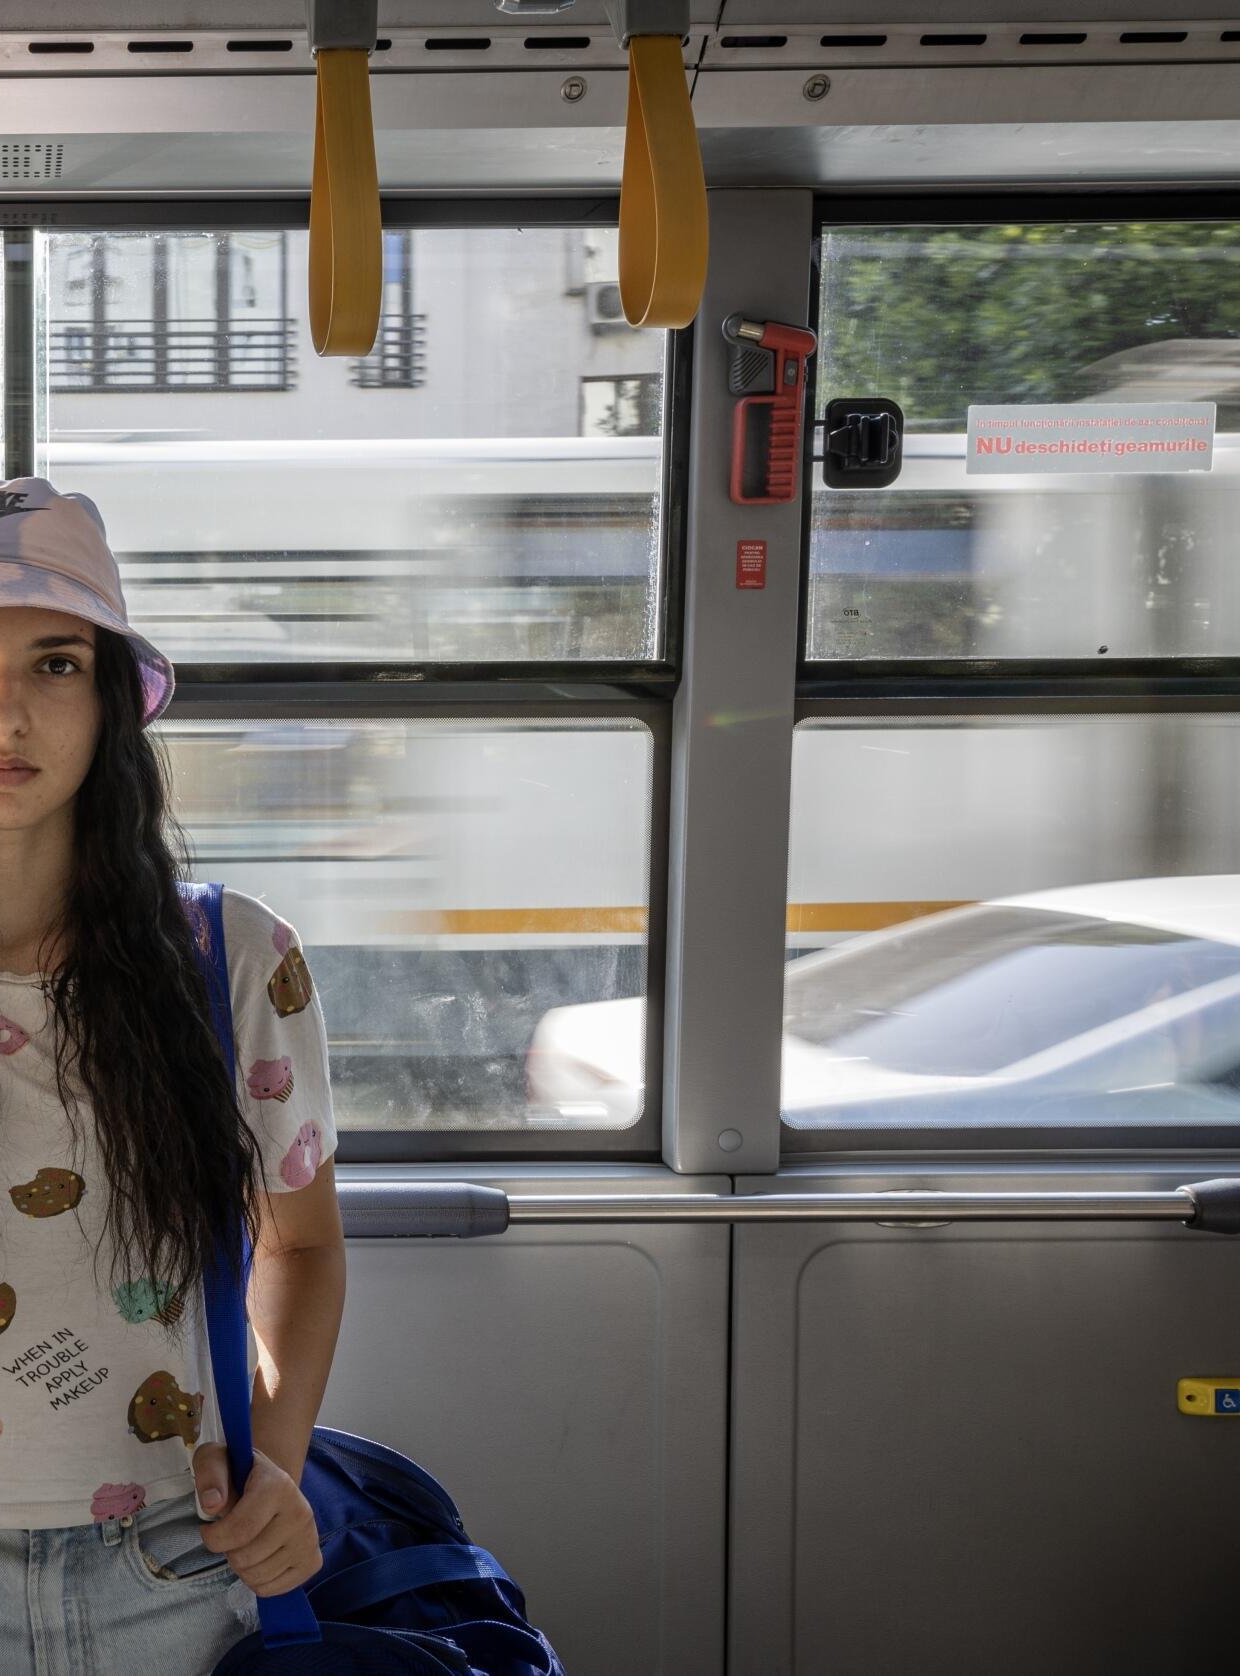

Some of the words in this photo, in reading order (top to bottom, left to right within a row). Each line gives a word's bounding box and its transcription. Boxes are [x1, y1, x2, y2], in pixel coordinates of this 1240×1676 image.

[976, 436, 1012, 454] NU
[1114, 438, 1208, 456] geamurile
[2, 1340, 53, 1374] WHEN
[51, 1327, 75, 1344] IN
[15, 1339, 89, 1387] TROUBLE
[45, 1360, 88, 1393] APPLY
[49, 1367, 109, 1411] MAKEUP
